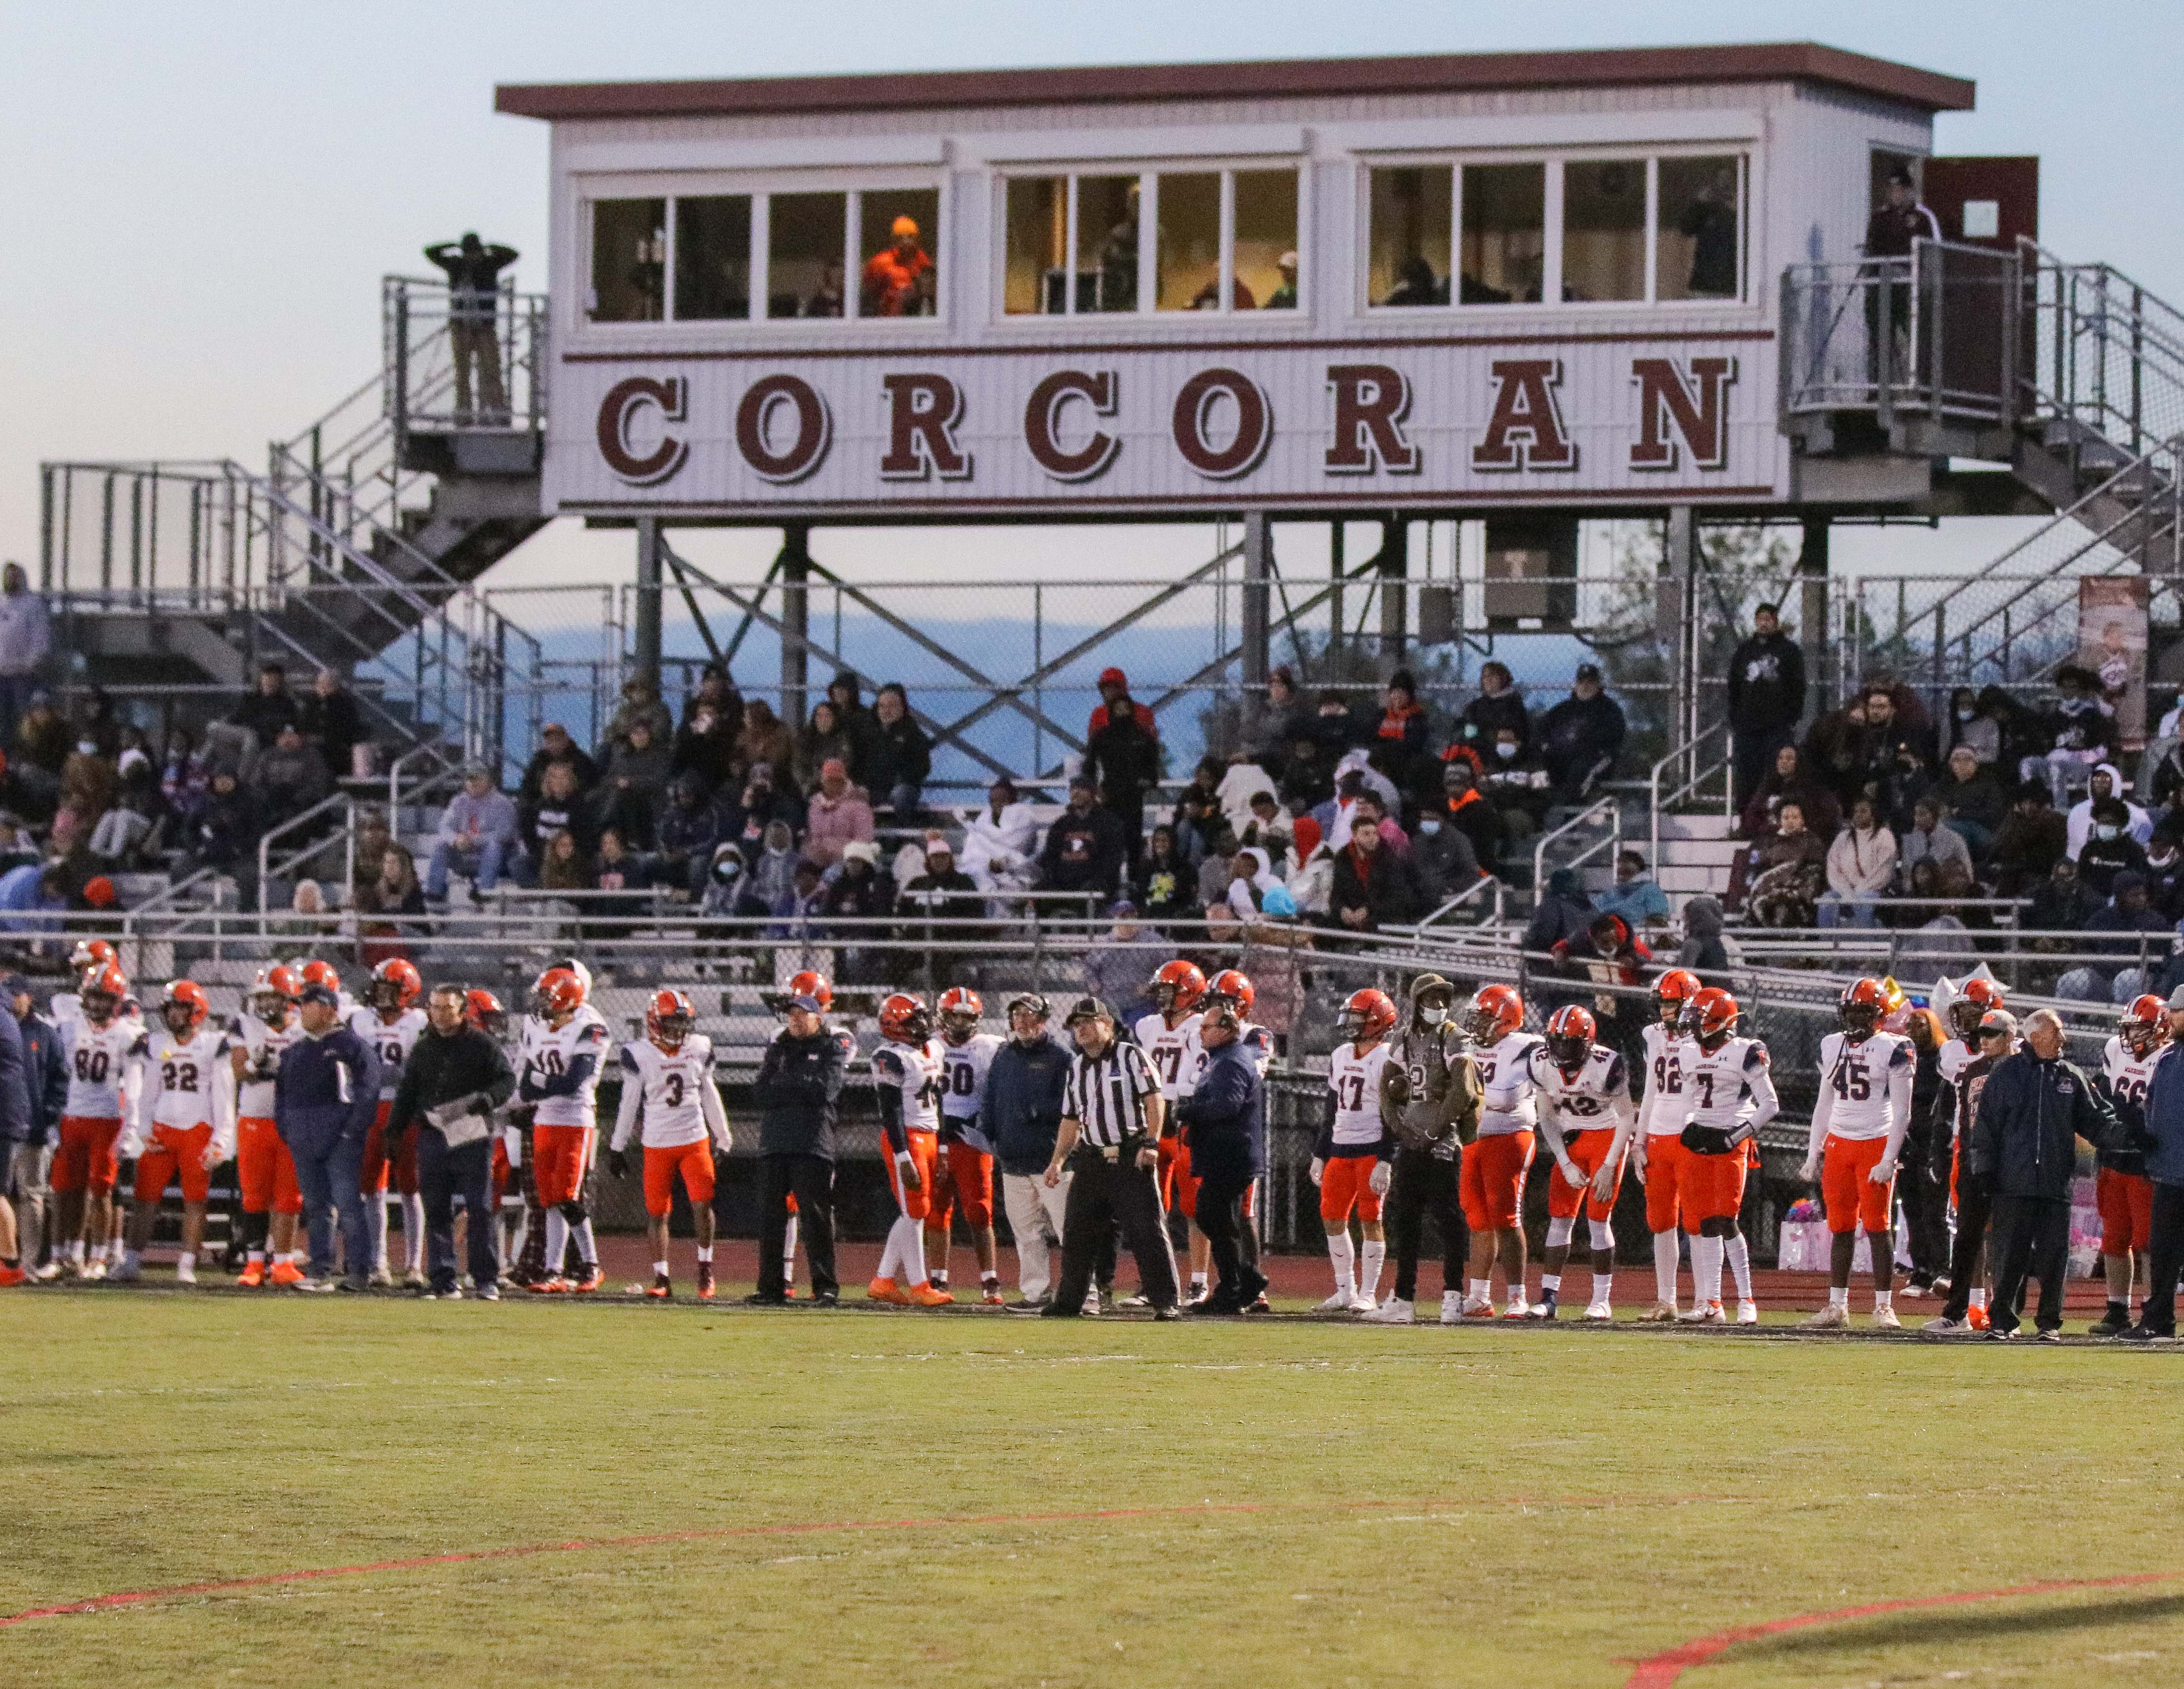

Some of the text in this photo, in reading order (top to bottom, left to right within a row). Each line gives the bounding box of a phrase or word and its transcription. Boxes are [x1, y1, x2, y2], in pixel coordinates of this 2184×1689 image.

[597, 355, 1739, 486] CORCORAN
[666, 1073, 684, 1107] 3
[1655, 1056, 1682, 1093] 92
[1697, 1073, 1713, 1109] 7
[1832, 1063, 1871, 1101] 45
[1338, 1075, 1365, 1112] 17
